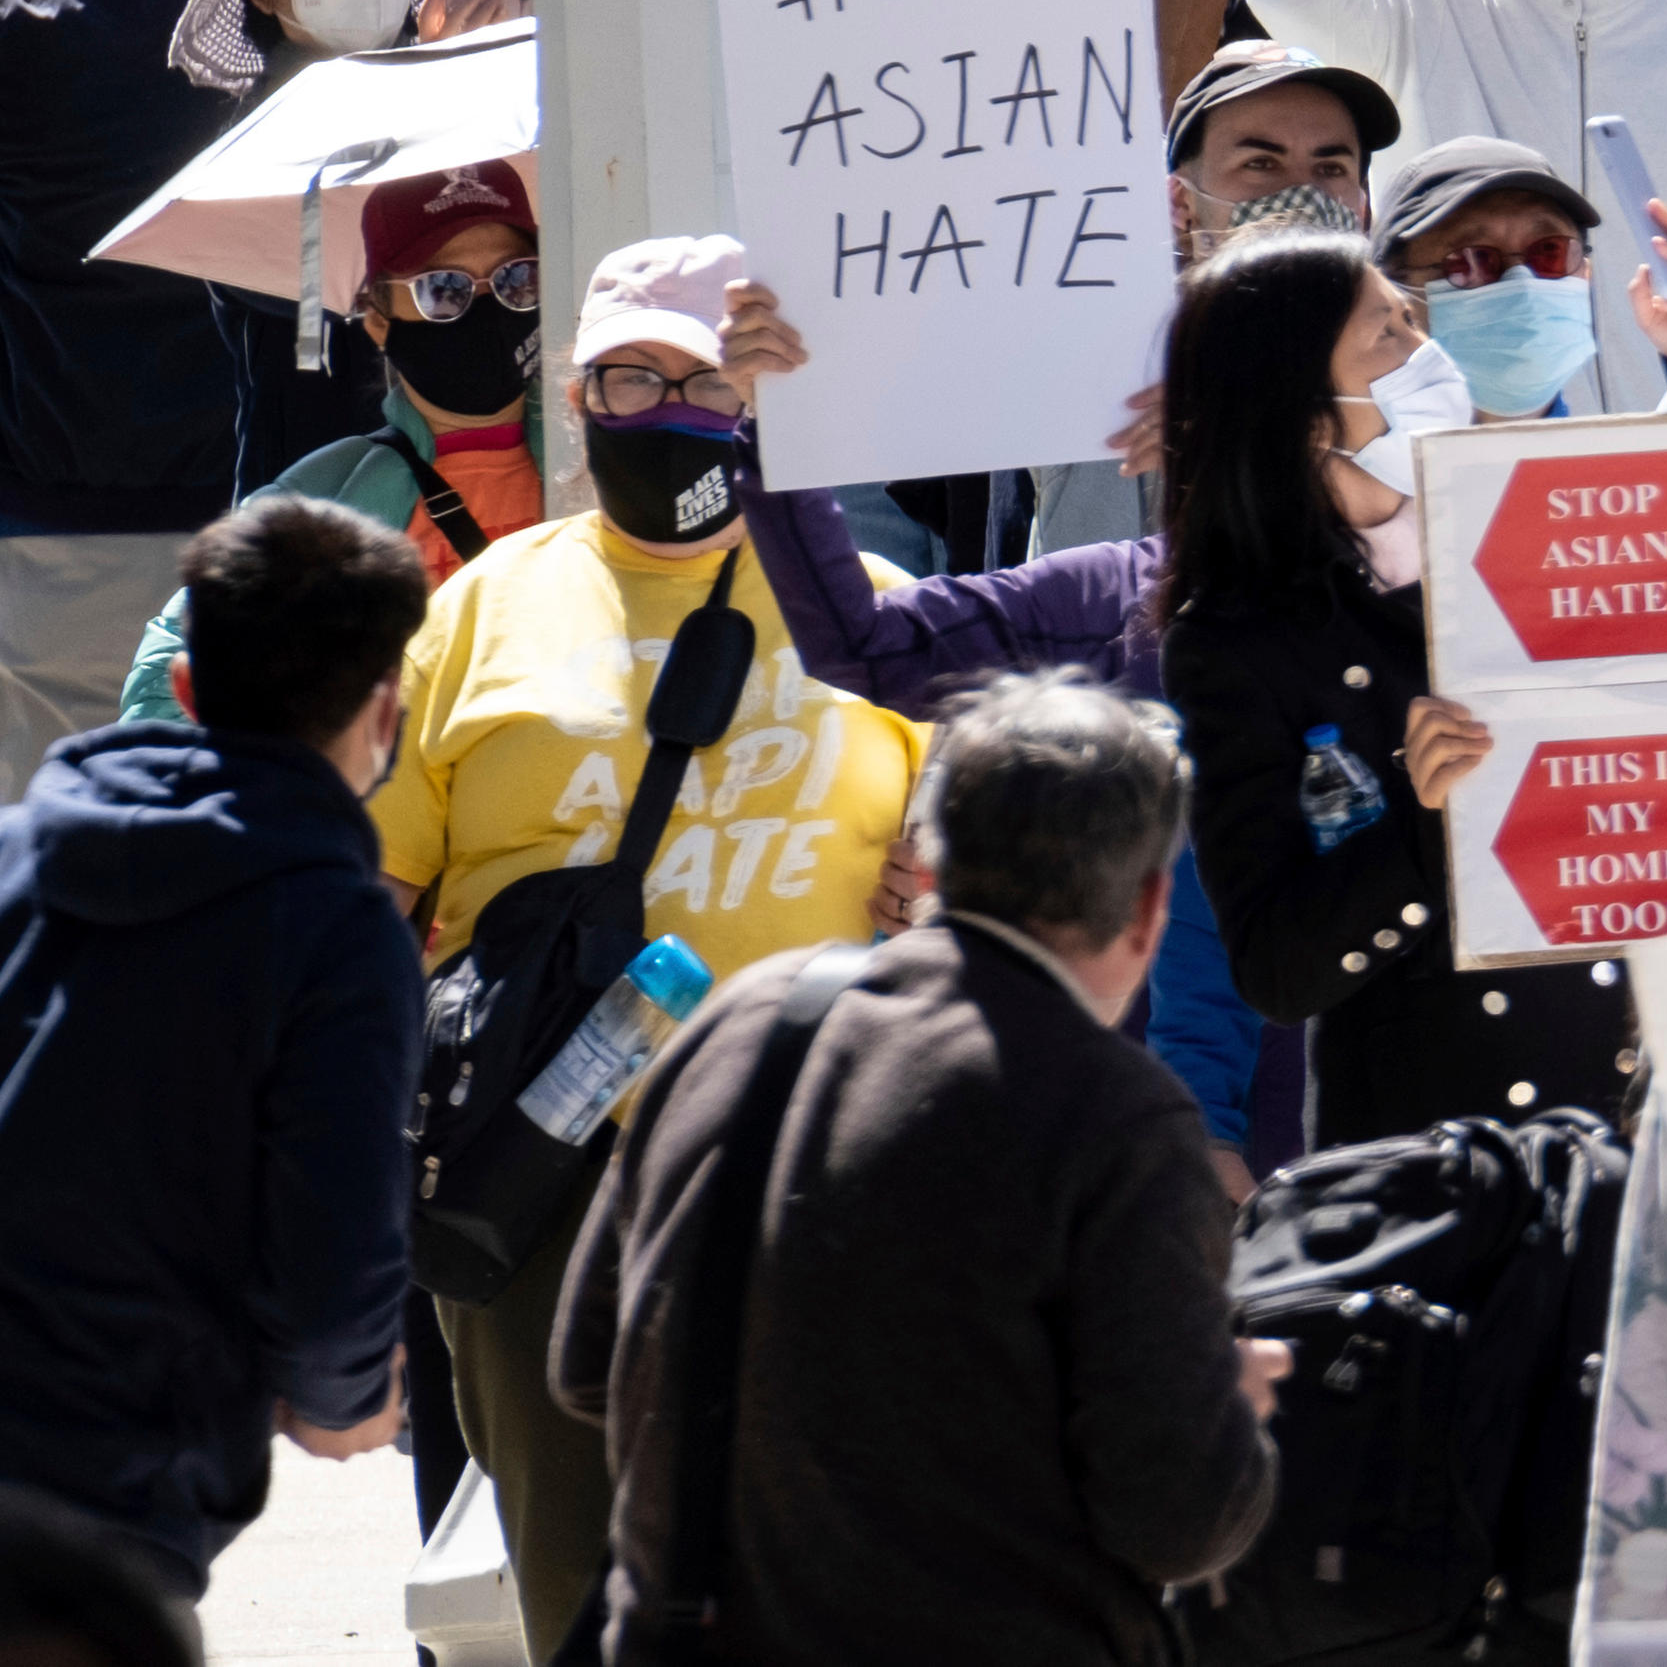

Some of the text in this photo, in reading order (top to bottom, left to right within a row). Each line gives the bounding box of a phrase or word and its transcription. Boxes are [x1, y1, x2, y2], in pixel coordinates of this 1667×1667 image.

[780, 29, 1133, 166] ASIAN
[834, 186, 1128, 297] HATE
[674, 464, 723, 509] BLACK
[676, 480, 728, 523] LIVES
[1548, 484, 1660, 521] STOP
[677, 495, 728, 532] MATTER
[1541, 752, 1641, 789] THIS
[1586, 801, 1656, 836] MY
